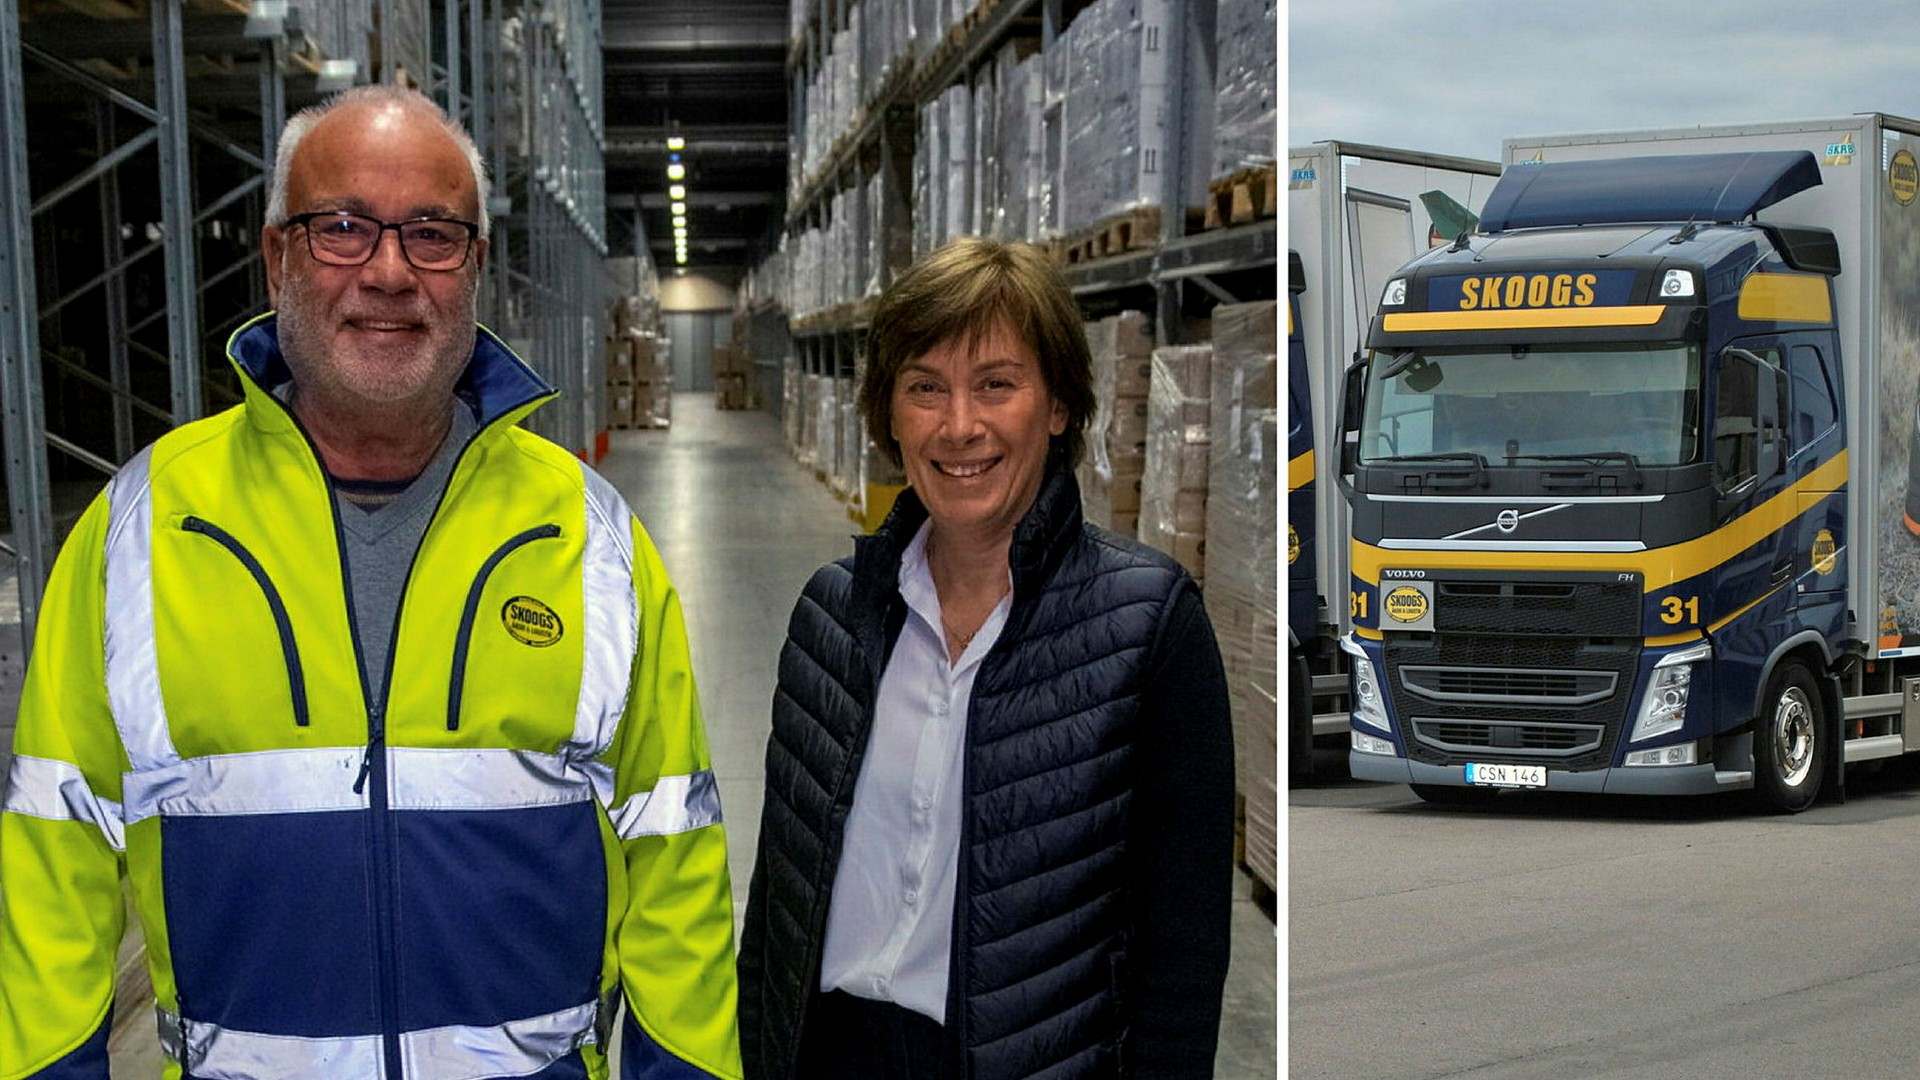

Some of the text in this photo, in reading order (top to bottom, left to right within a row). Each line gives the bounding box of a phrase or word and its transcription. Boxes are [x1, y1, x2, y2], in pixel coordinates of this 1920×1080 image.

[1826, 144, 1854, 154] SKAB
[1460, 274, 1597, 310] SKOOGS
[1385, 570, 1425, 578] VOLVO
[1618, 573, 1634, 581] FH
[1390, 594, 1422, 607] SKOOGS
[511, 604, 553, 630] SKOOGS
[1660, 595, 1699, 624] 31
[1479, 766, 1539, 783] CSN 146
